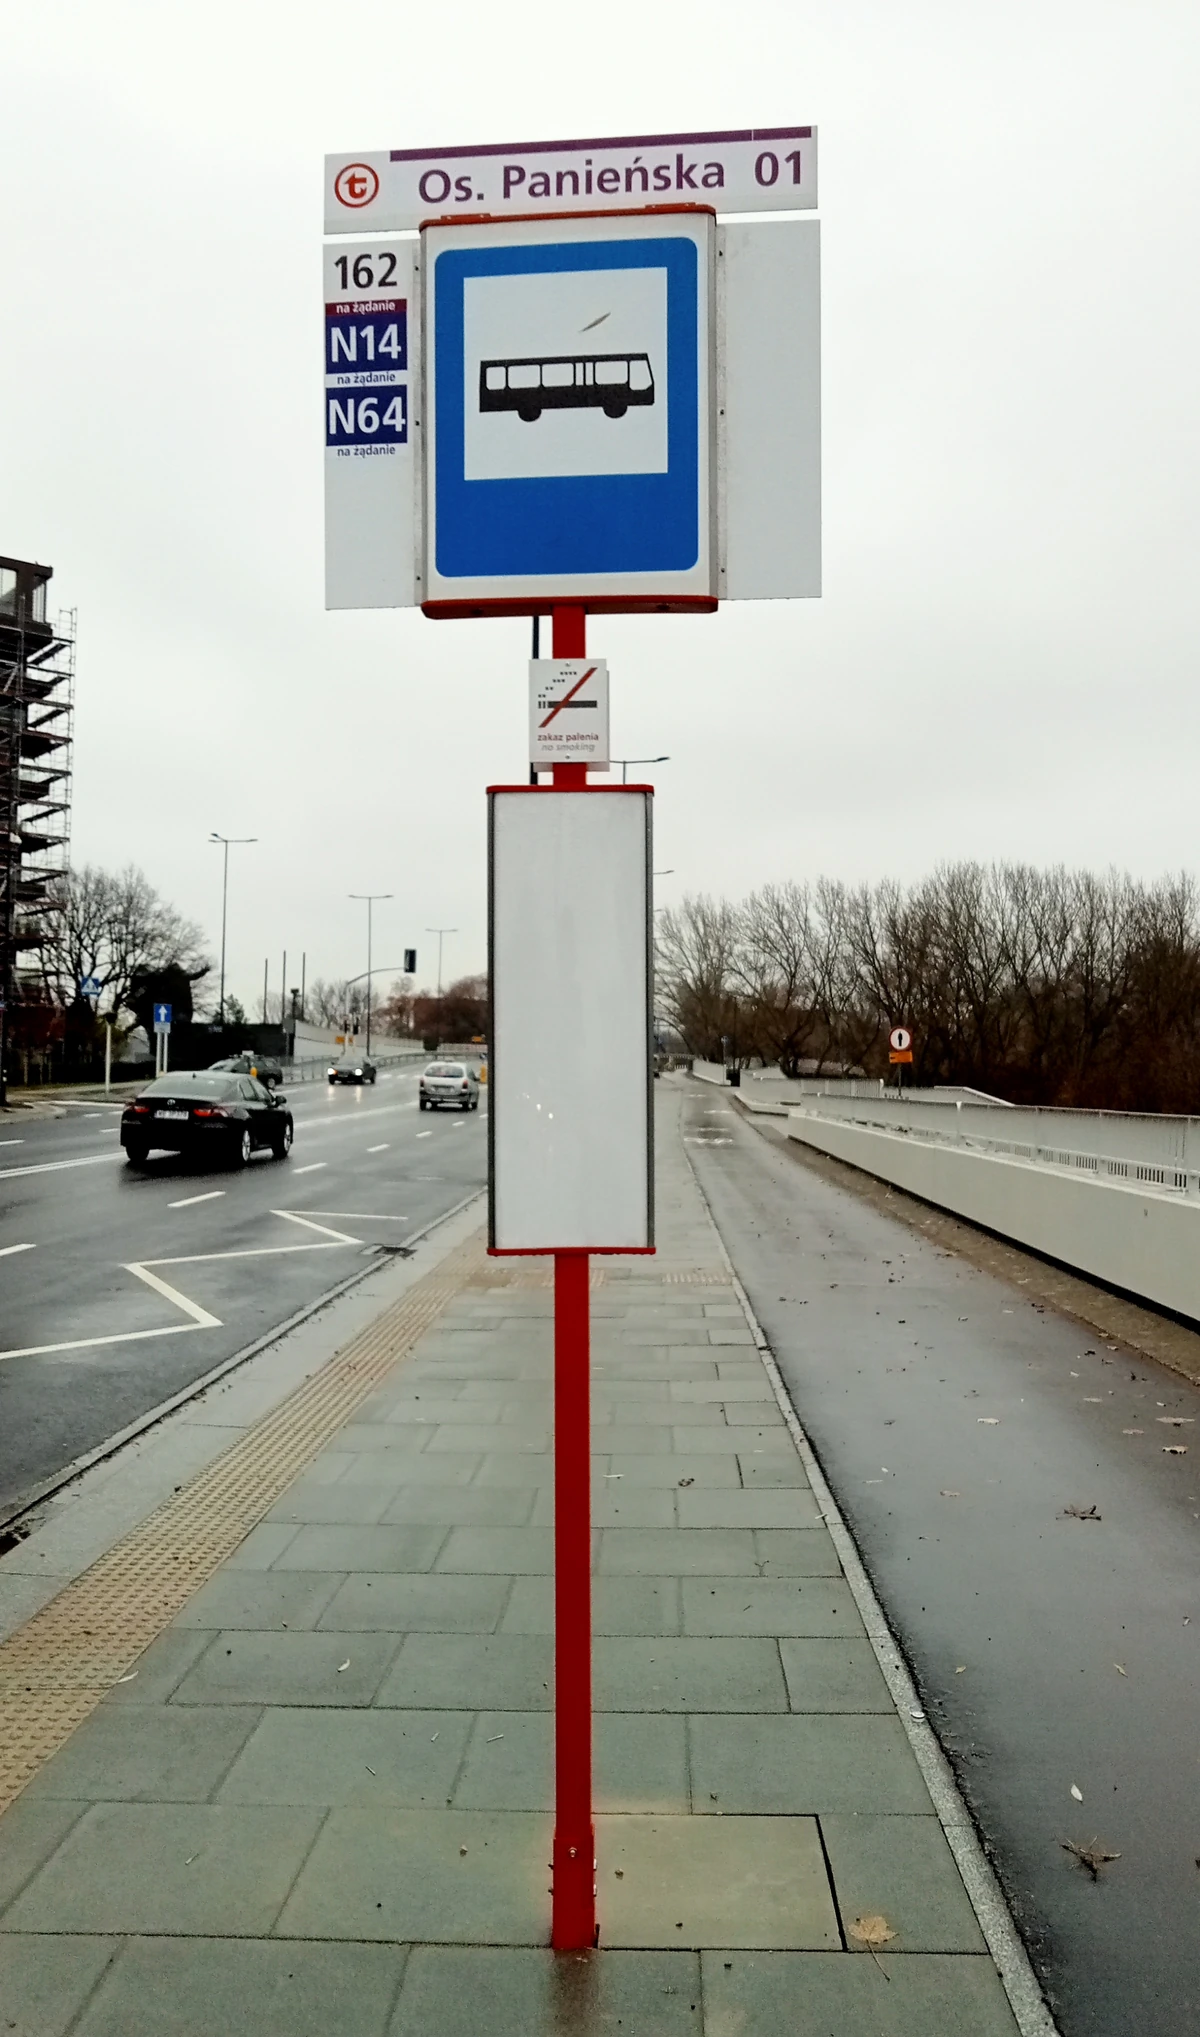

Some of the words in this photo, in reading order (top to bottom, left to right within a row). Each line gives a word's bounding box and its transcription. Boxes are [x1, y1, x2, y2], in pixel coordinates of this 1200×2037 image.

[418, 168, 484, 204] Os.
[502, 153, 725, 200] Panieńska
[754, 149, 801, 187] 01
[334, 252, 398, 290] 162
[336, 304, 350, 314] na
[352, 300, 396, 315] żądanie
[331, 323, 402, 363] N14
[337, 375, 351, 385] na
[353, 372, 396, 387] żądanie
[329, 396, 406, 435] N64
[337, 447, 351, 457] na
[353, 444, 396, 459] żądanie
[537, 733, 563, 742] zakaz
[565, 732, 599, 743] palenia
[556, 743, 595, 752] smoking
